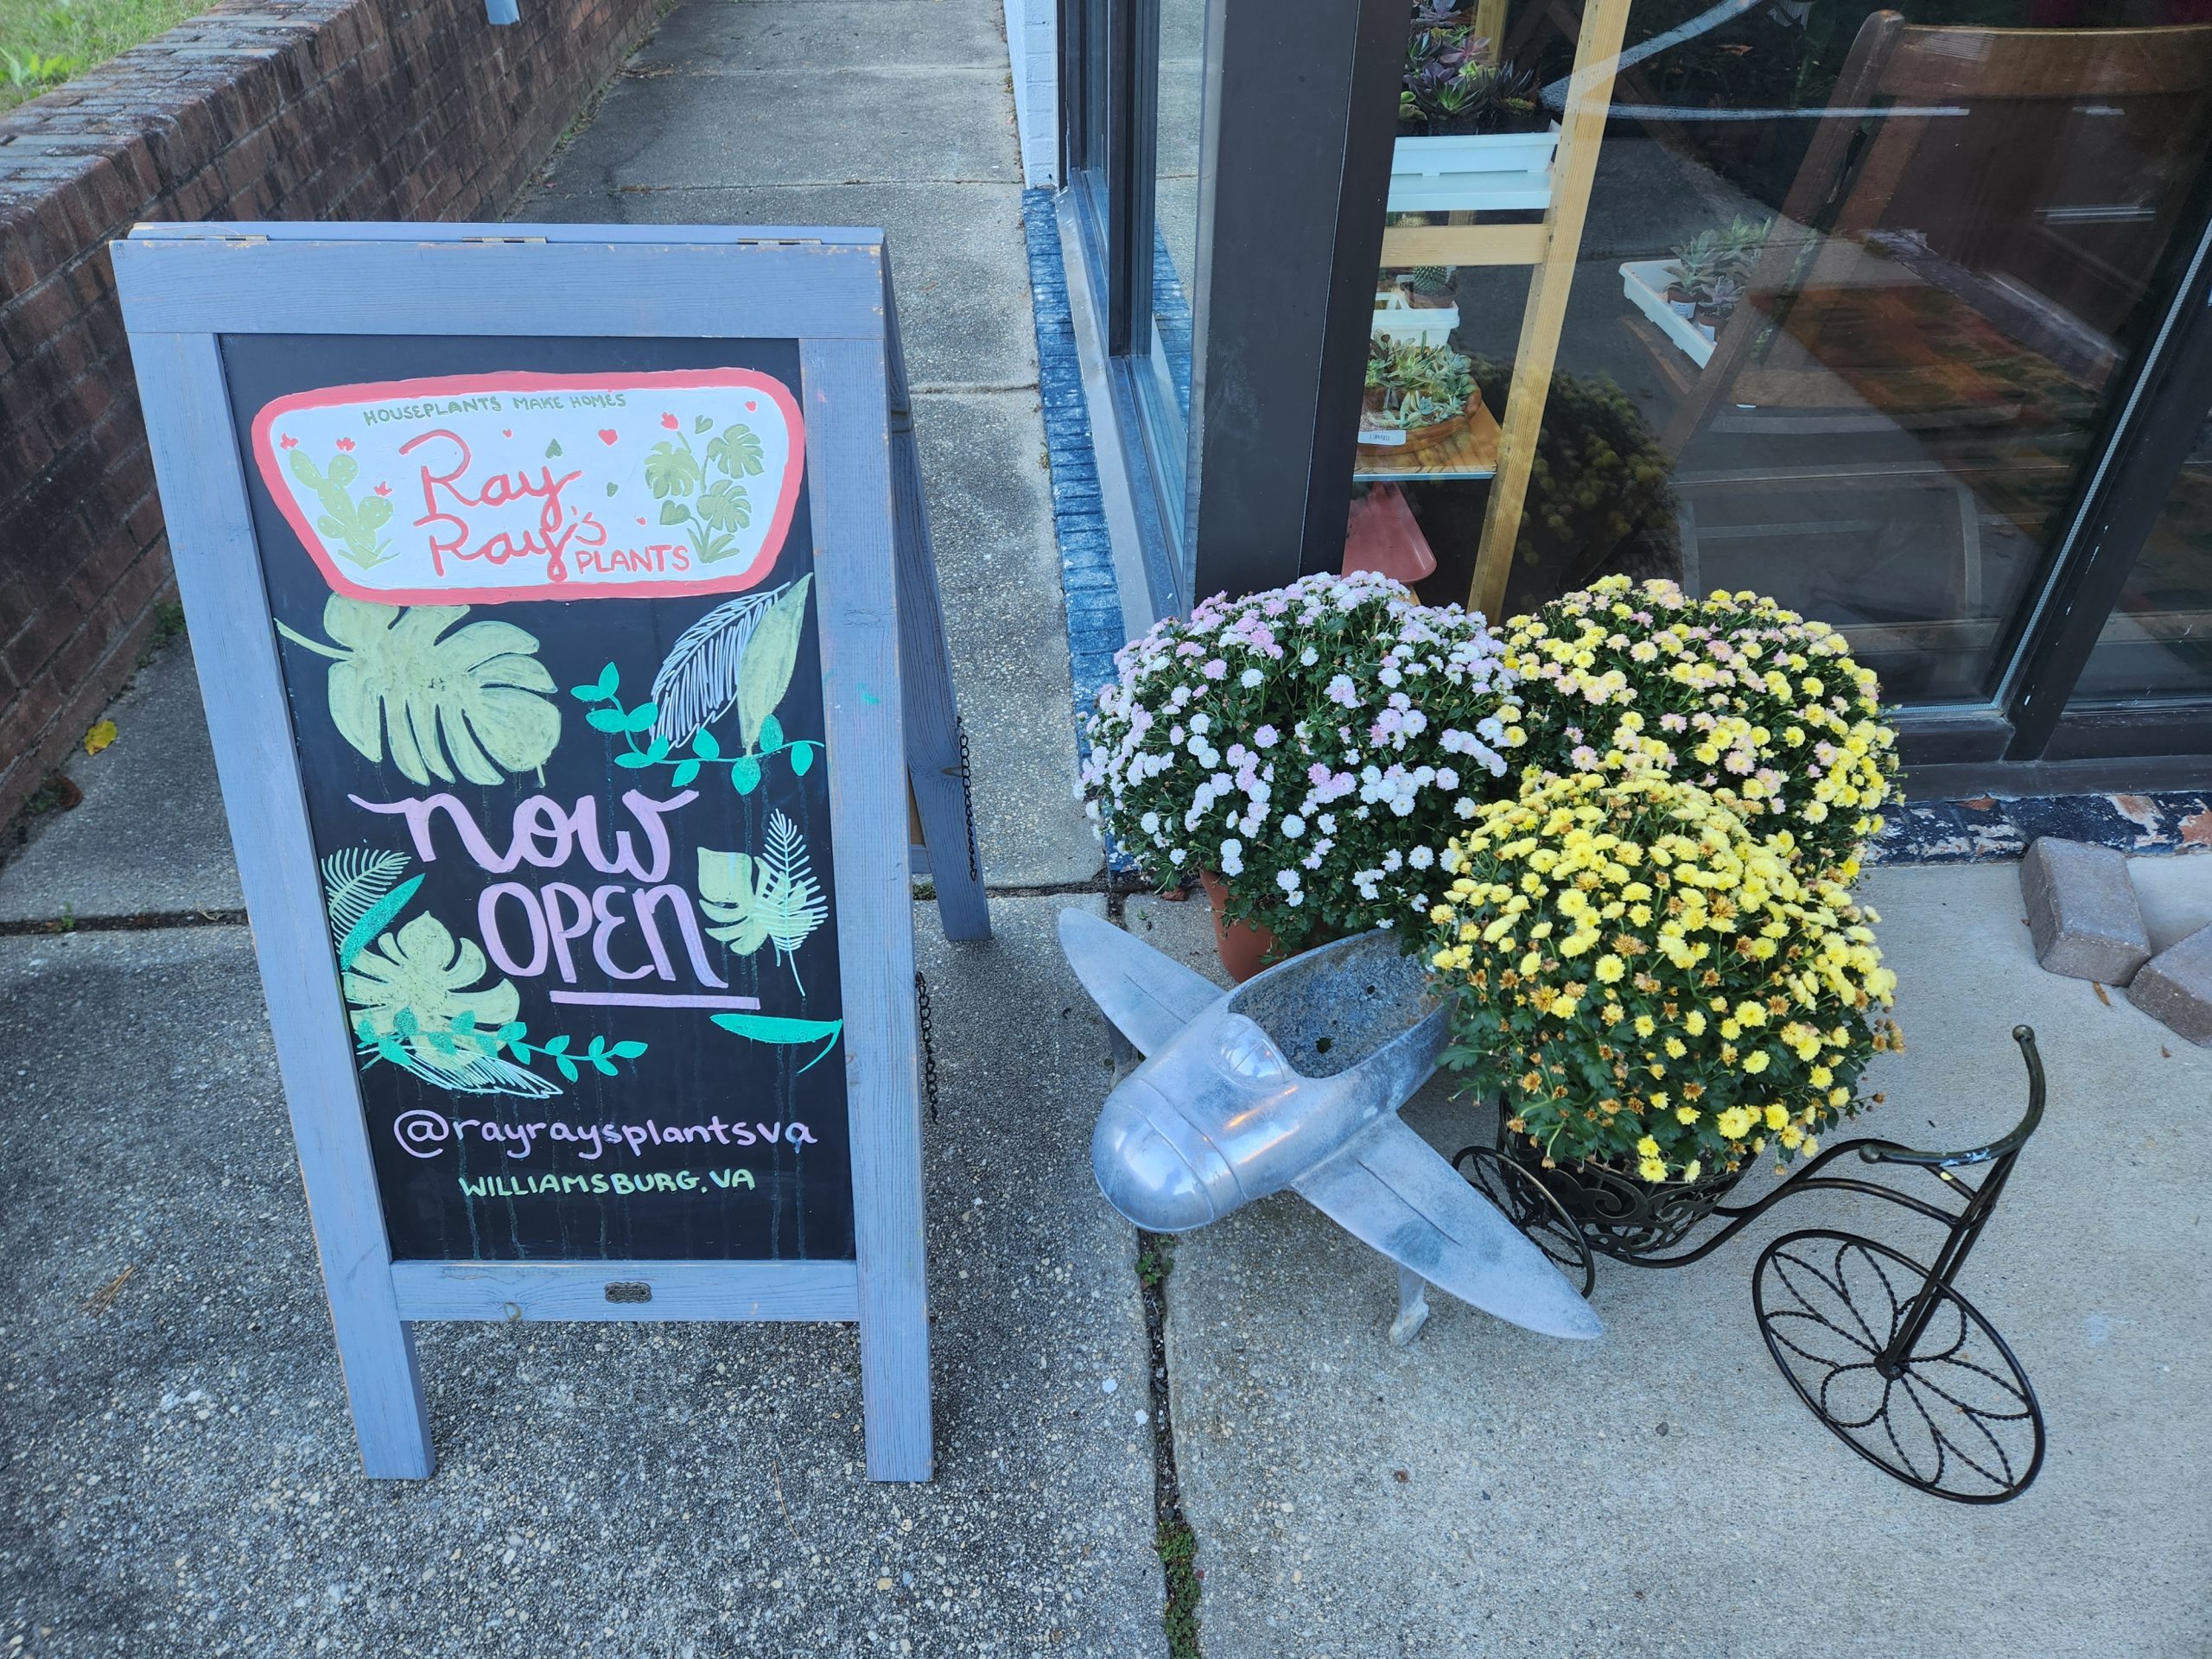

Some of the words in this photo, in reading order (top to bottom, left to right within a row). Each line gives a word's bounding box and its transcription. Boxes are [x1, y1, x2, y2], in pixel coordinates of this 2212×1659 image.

[363, 397, 502, 426] HOUSEPLANTS
[512, 397, 564, 410] MAKE
[569, 394, 626, 409] HOMES
[398, 429, 582, 532] Ray
[413, 505, 607, 582] Ray's
[576, 545, 690, 574] PLANTS
[478, 881, 728, 988] OPEN
[393, 1109, 818, 1159] @rayraysplantsva
